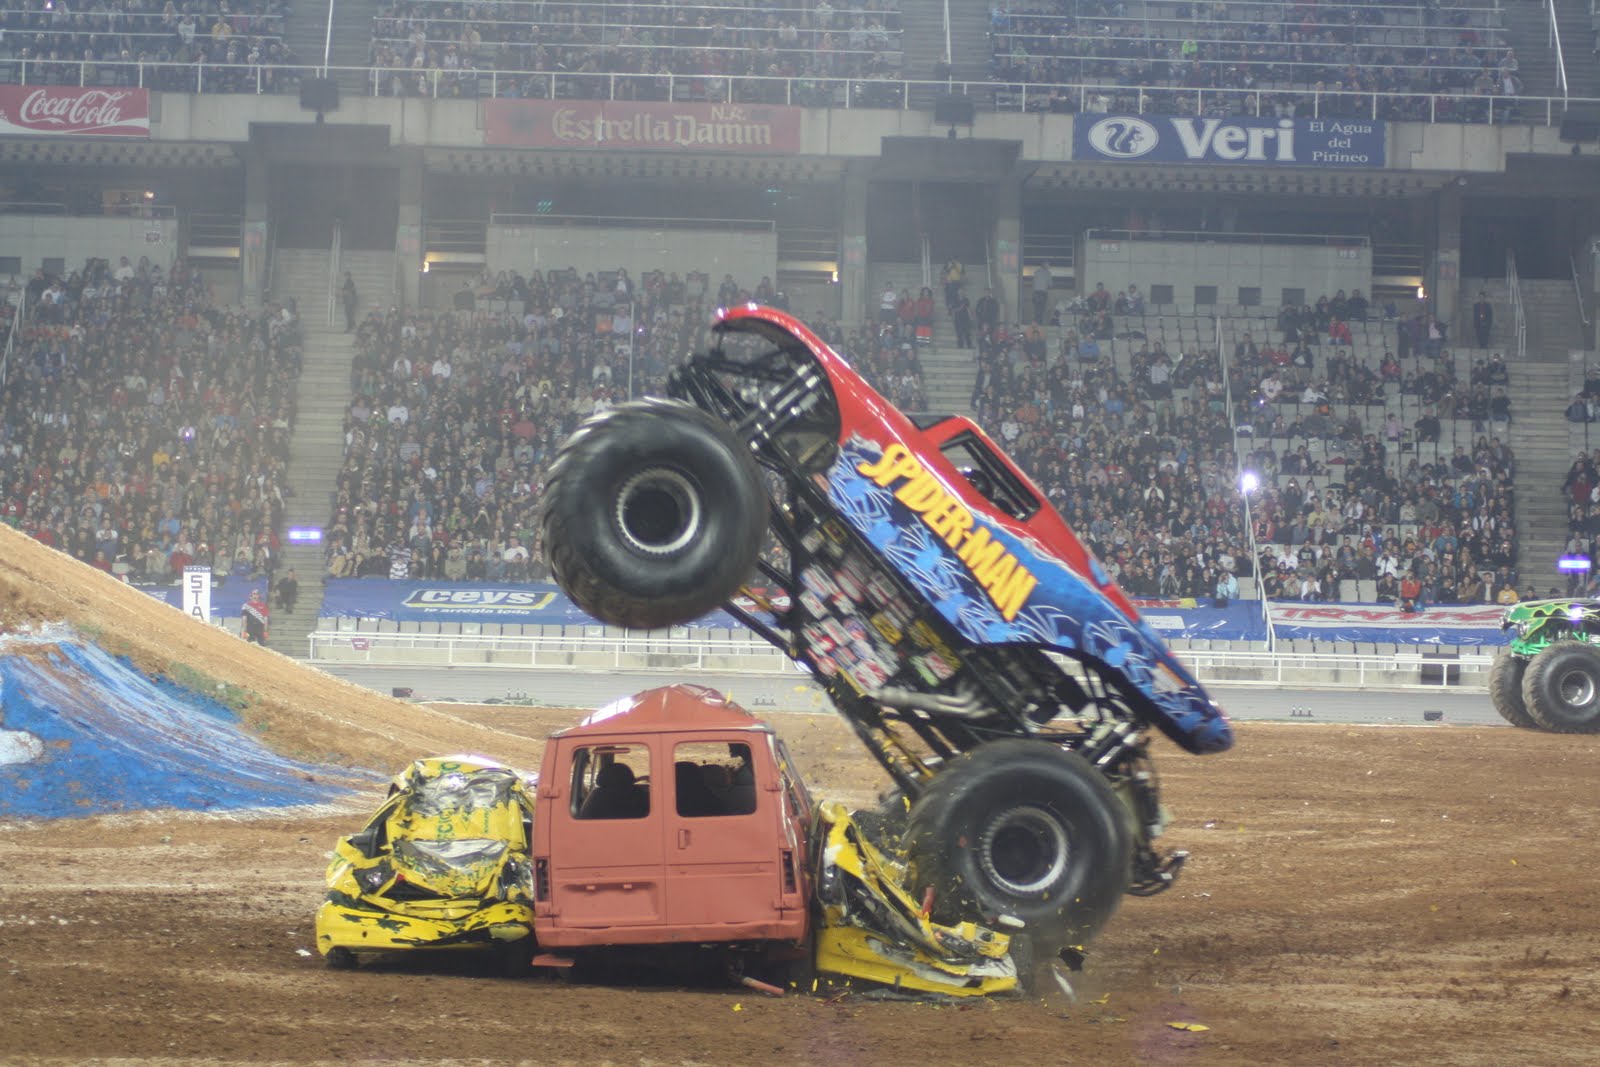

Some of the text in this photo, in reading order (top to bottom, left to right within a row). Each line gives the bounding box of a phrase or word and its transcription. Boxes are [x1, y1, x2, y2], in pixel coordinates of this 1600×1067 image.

[552, 107, 772, 146] Estrella Damm
[1309, 121, 1372, 136] El Agua
[1169, 117, 1297, 162] Veri
[1328, 137, 1351, 149] del
[1312, 151, 1369, 163] Pirineo
[420, 589, 537, 605] ceys
